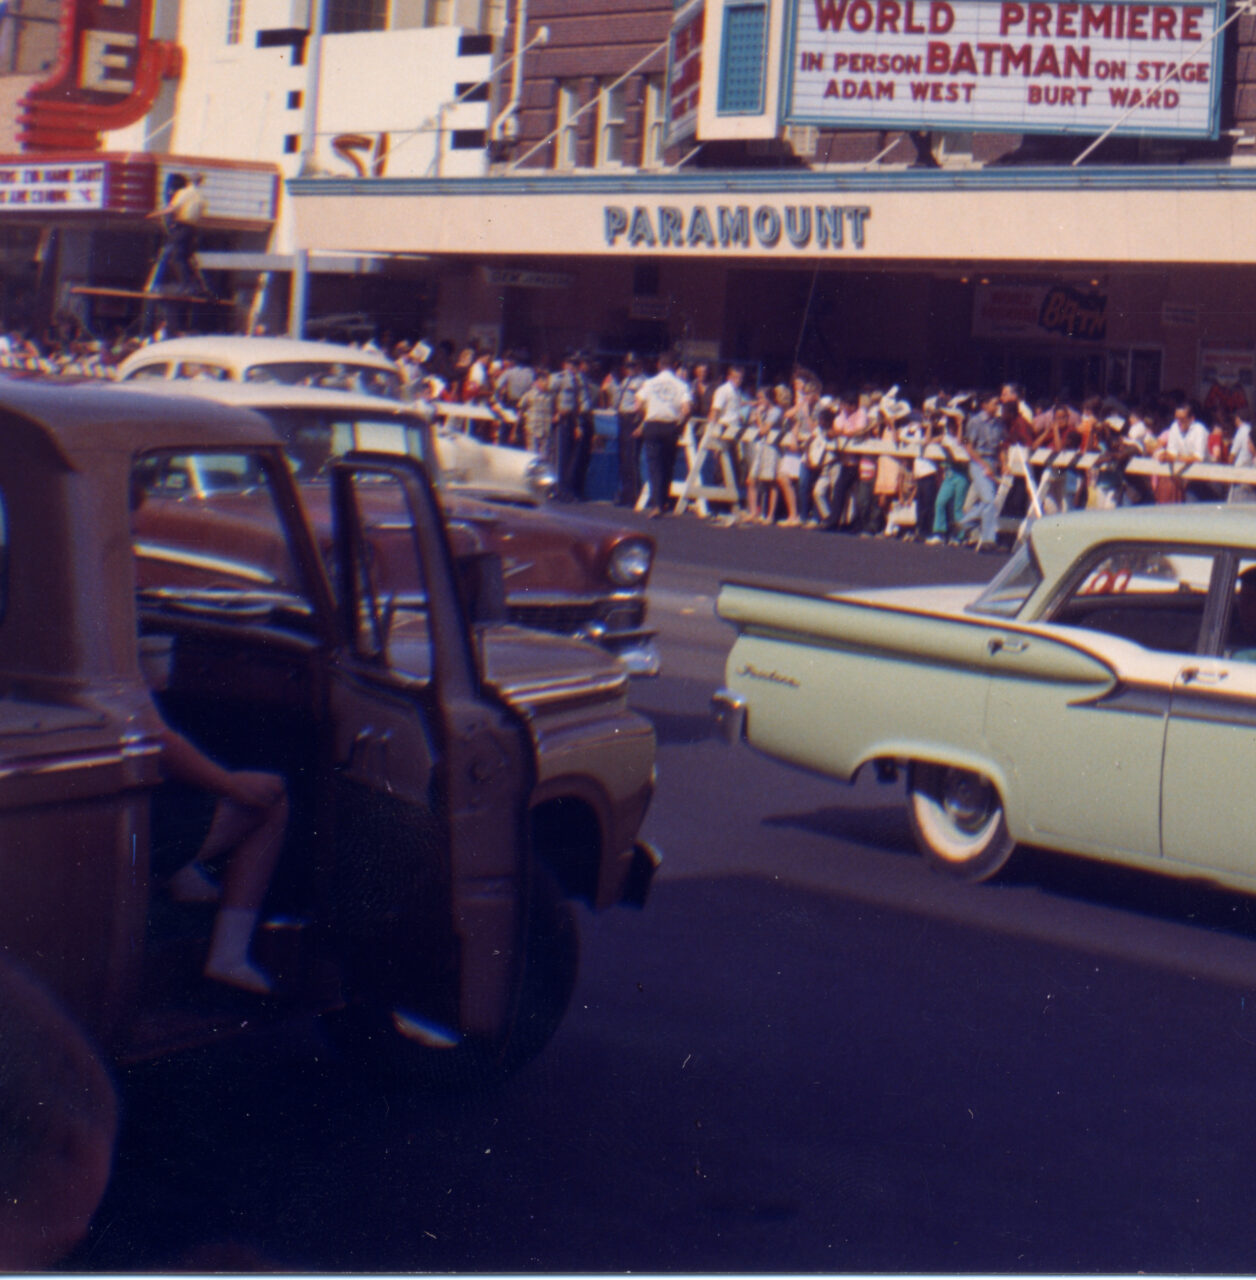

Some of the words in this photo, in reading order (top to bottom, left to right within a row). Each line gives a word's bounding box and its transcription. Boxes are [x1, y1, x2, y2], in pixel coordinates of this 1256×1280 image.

[1000, 3, 1204, 40] PREMIERE
[801, 52, 823, 71] IN
[833, 53, 921, 74] PERSON
[927, 42, 1090, 78] BATMAN
[1095, 60, 1127, 81] ON
[1136, 61, 1209, 83] STAGE
[824, 80, 894, 101] ADAM
[911, 83, 976, 103] WEST
[1028, 86, 1092, 107] BURT
[1109, 88, 1180, 110] WARD
[604, 206, 871, 248] PARAMOUNT
